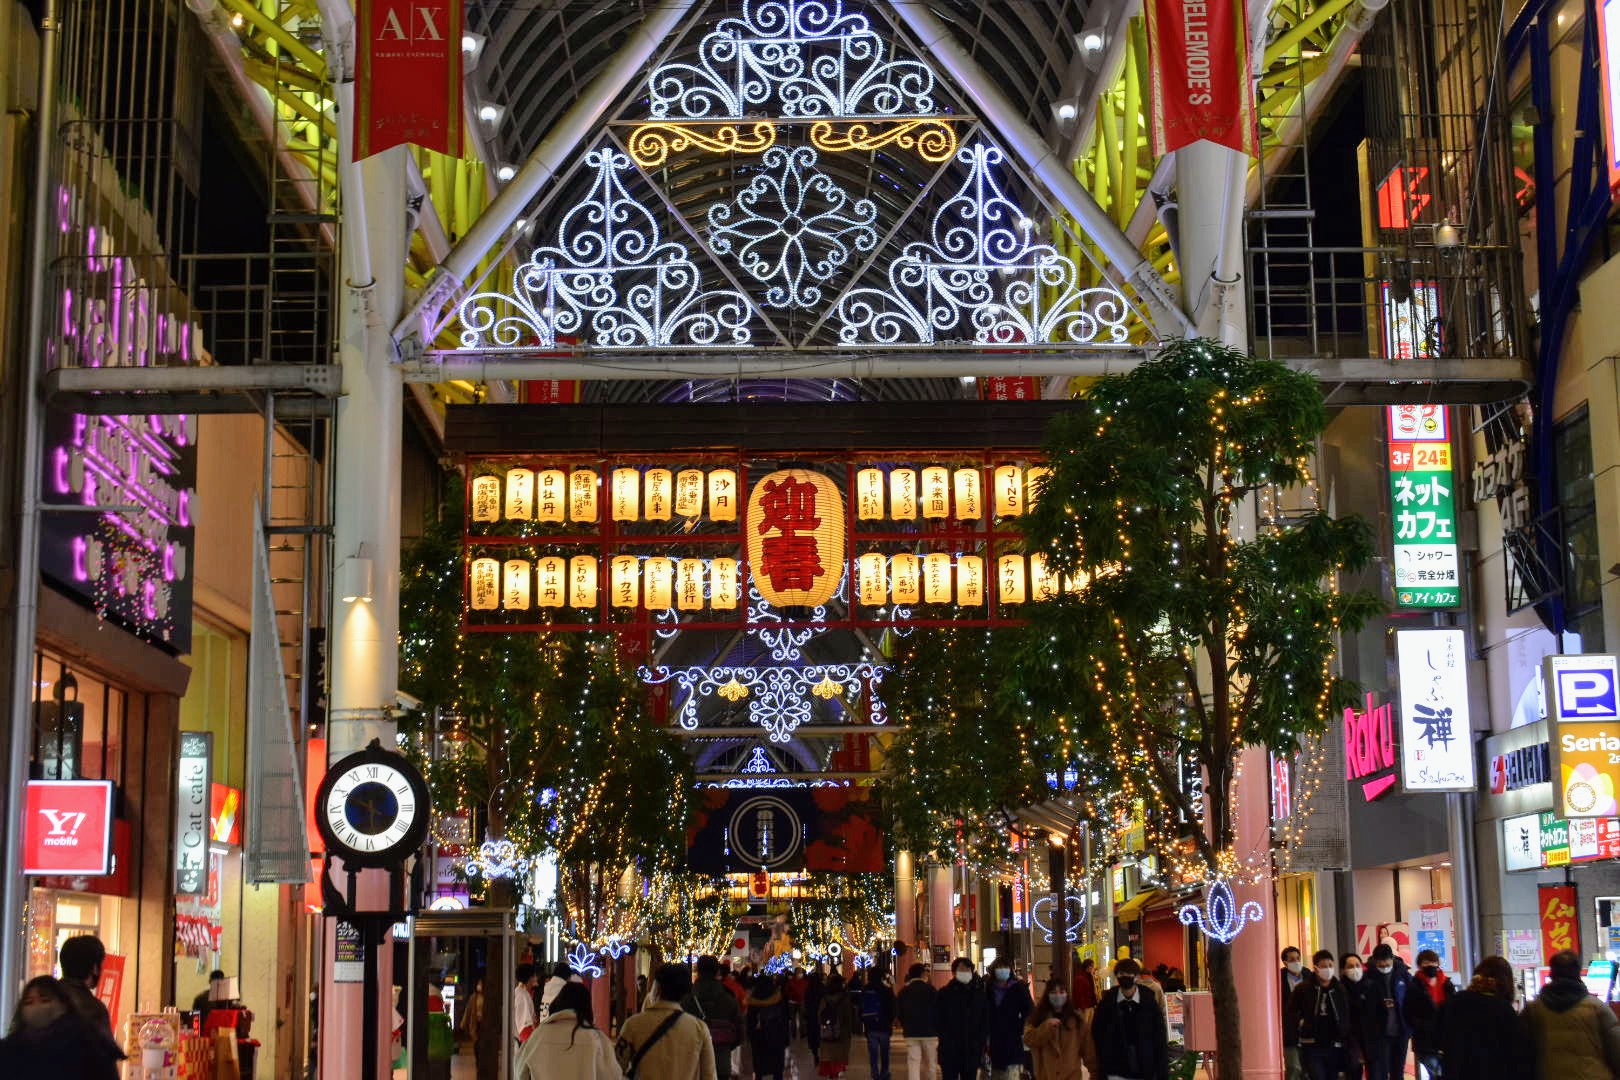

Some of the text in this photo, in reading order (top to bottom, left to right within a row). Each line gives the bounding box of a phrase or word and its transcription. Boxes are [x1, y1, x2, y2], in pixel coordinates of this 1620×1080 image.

[1392, 450, 1411, 465] 3F
[514, 473, 525, 515] フォーラス
[542, 474, 555, 514] 白牡丹
[715, 478, 730, 508] 沙月
[932, 472, 944, 512] 永楽園
[1007, 469, 1017, 507] JINS
[1394, 475, 1450, 506] ネット
[1397, 510, 1452, 539] カフェ
[1417, 550, 1453, 562] シャワー
[511, 564, 520, 605] フォーラス
[545, 561, 557, 600] 白牡丹
[683, 562, 697, 604] 新生銀行
[1417, 569, 1456, 581] 完全分煙
[1560, 672, 1610, 710] P
[1561, 732, 1620, 752] Seria
[39, 808, 87, 835] Y!
[182, 813, 202, 848] Cat
[44, 836, 79, 846] mobile
[1542, 897, 1576, 950] 仙台
